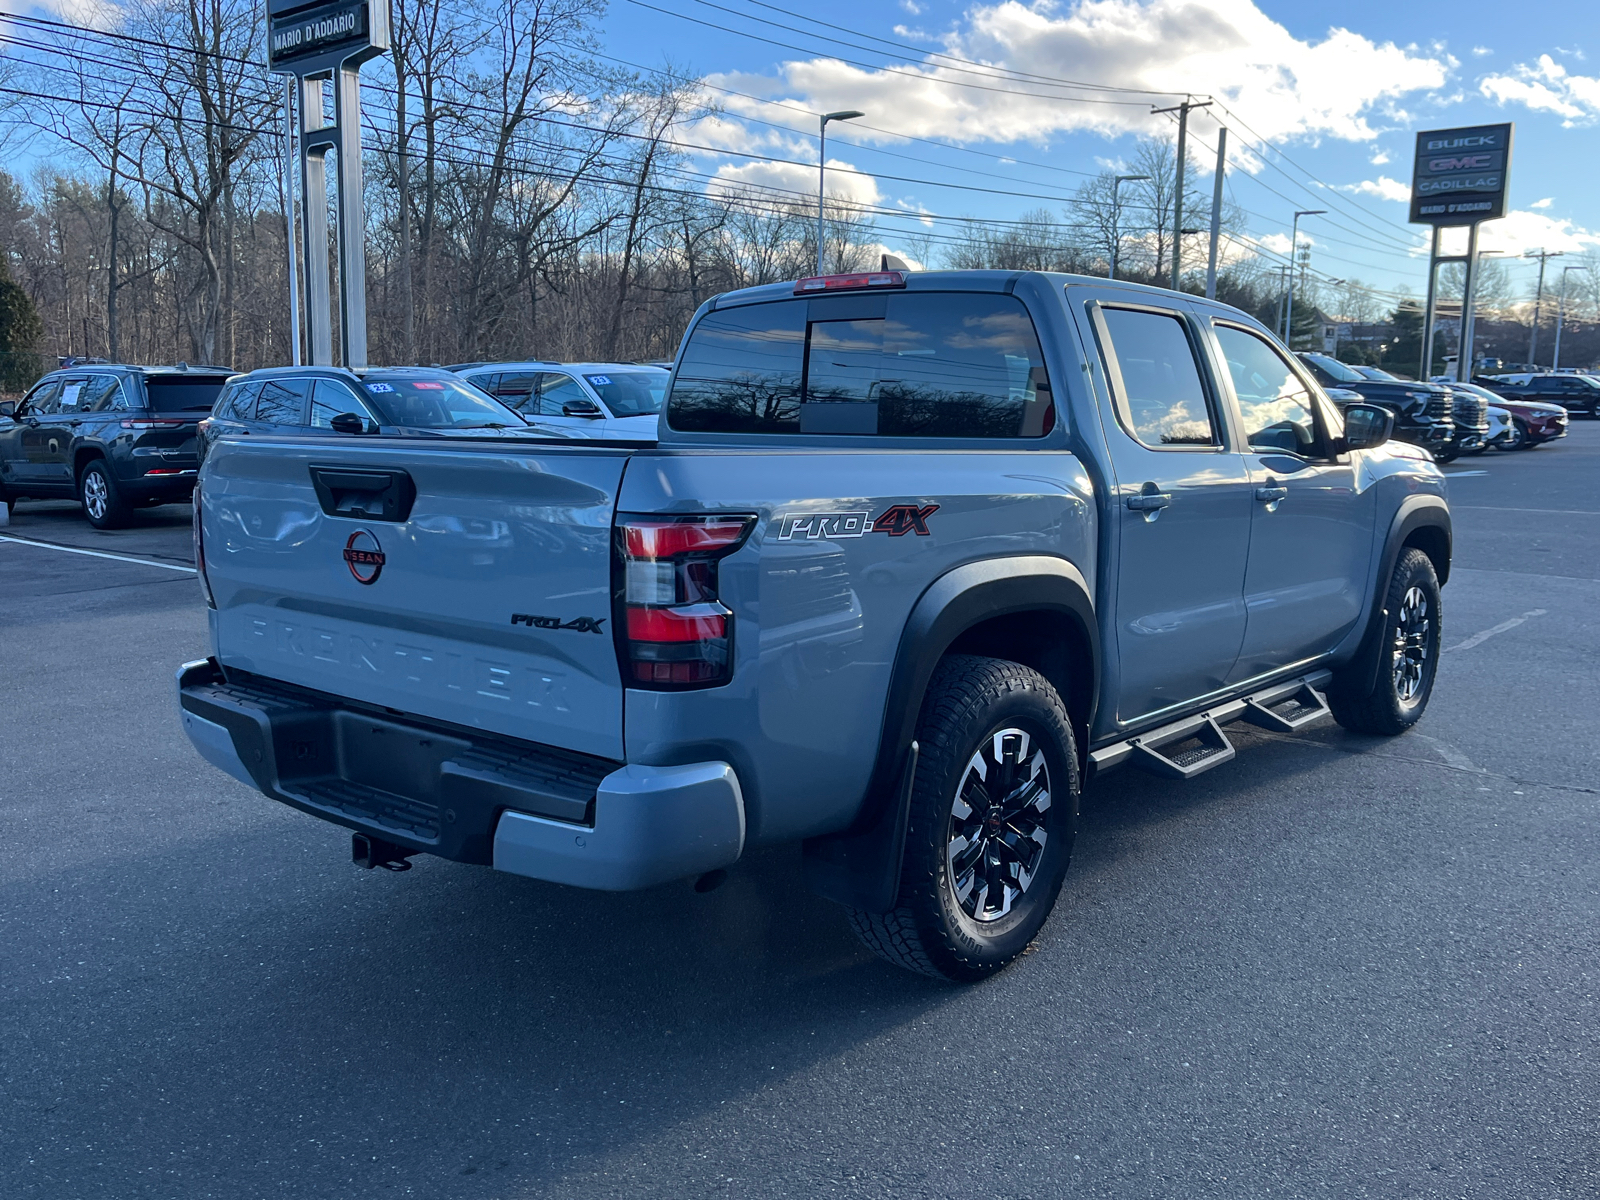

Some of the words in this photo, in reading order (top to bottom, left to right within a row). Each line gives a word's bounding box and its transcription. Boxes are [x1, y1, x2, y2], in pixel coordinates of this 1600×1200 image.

[274, 30, 301, 51] MARIO
[306, 13, 355, 41] D'ADDARIO
[1427, 135, 1496, 150] BUICK
[1429, 155, 1491, 171] GMC
[1419, 177, 1498, 191] CADILLAC
[778, 505, 941, 541] PRO-4X
[244, 612, 571, 713] FRONTIER
